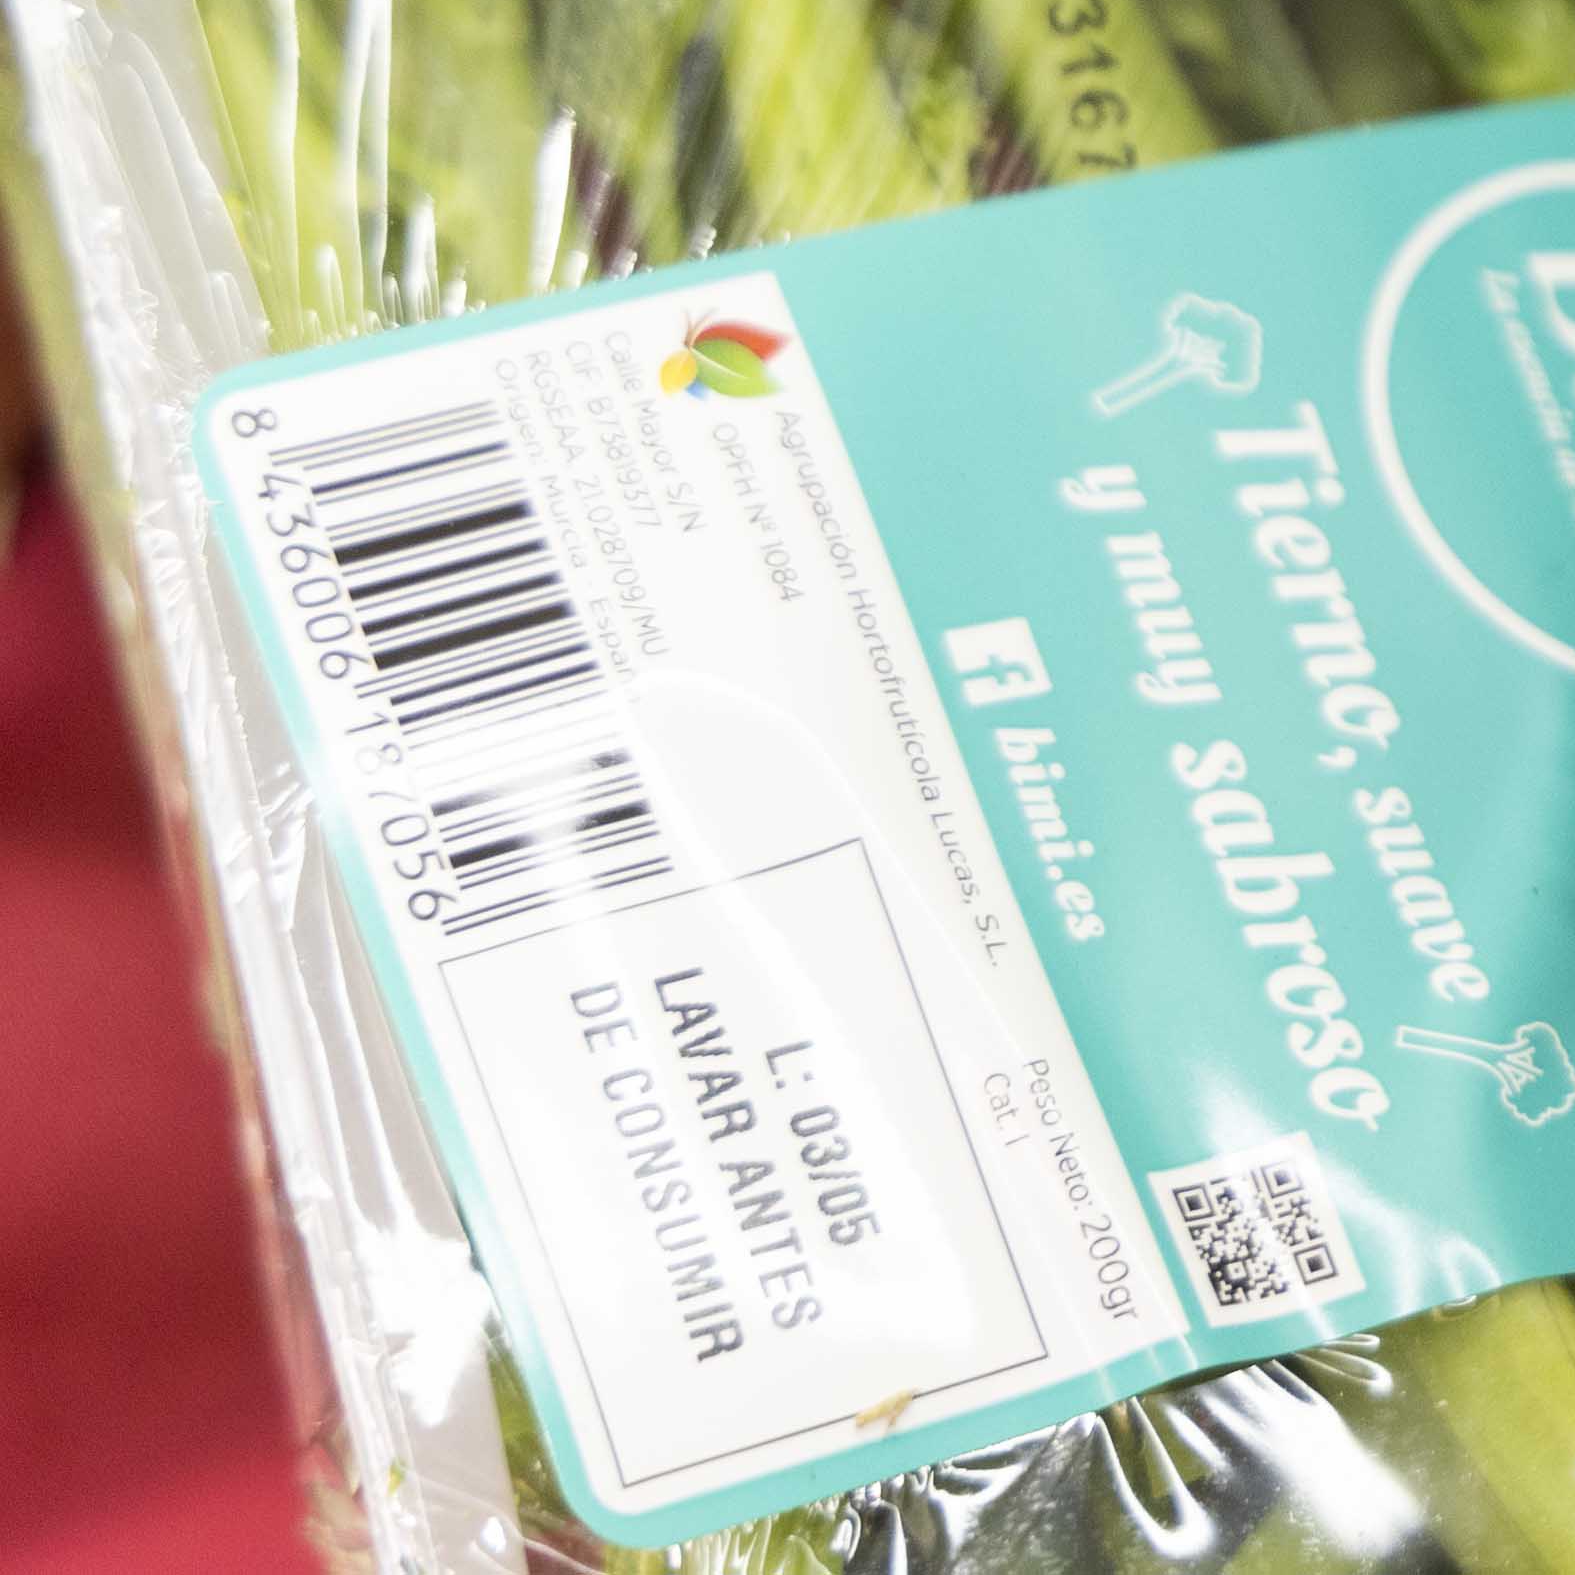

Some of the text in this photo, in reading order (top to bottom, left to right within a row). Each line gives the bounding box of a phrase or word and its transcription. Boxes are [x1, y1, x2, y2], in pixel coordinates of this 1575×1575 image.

[231, 406, 278, 438] 8
[256, 472, 374, 681] 436006
[540, 474, 587, 570] Murcia
[605, 330, 709, 534] Calle Mayor S/N
[711, 422, 764, 498] OPFH
[760, 537, 806, 602] 1084
[774, 410, 1008, 968] Agrupación Hortofrutícola Lucas, S.L.
[1059, 462, 1392, 1131] y muy sabroso
[1214, 399, 1491, 1003] Tierno, suave
[994, 726, 1106, 942] bimi.es
[569, 980, 745, 1364] DE CONSUMIR
[653, 966, 825, 1331] LAVAR ANTES
[765, 1040, 883, 1247] L: 03/05
[983, 1072, 1020, 1130] Cat.
[1023, 1057, 1139, 1321] Peso Neto: 200gr
